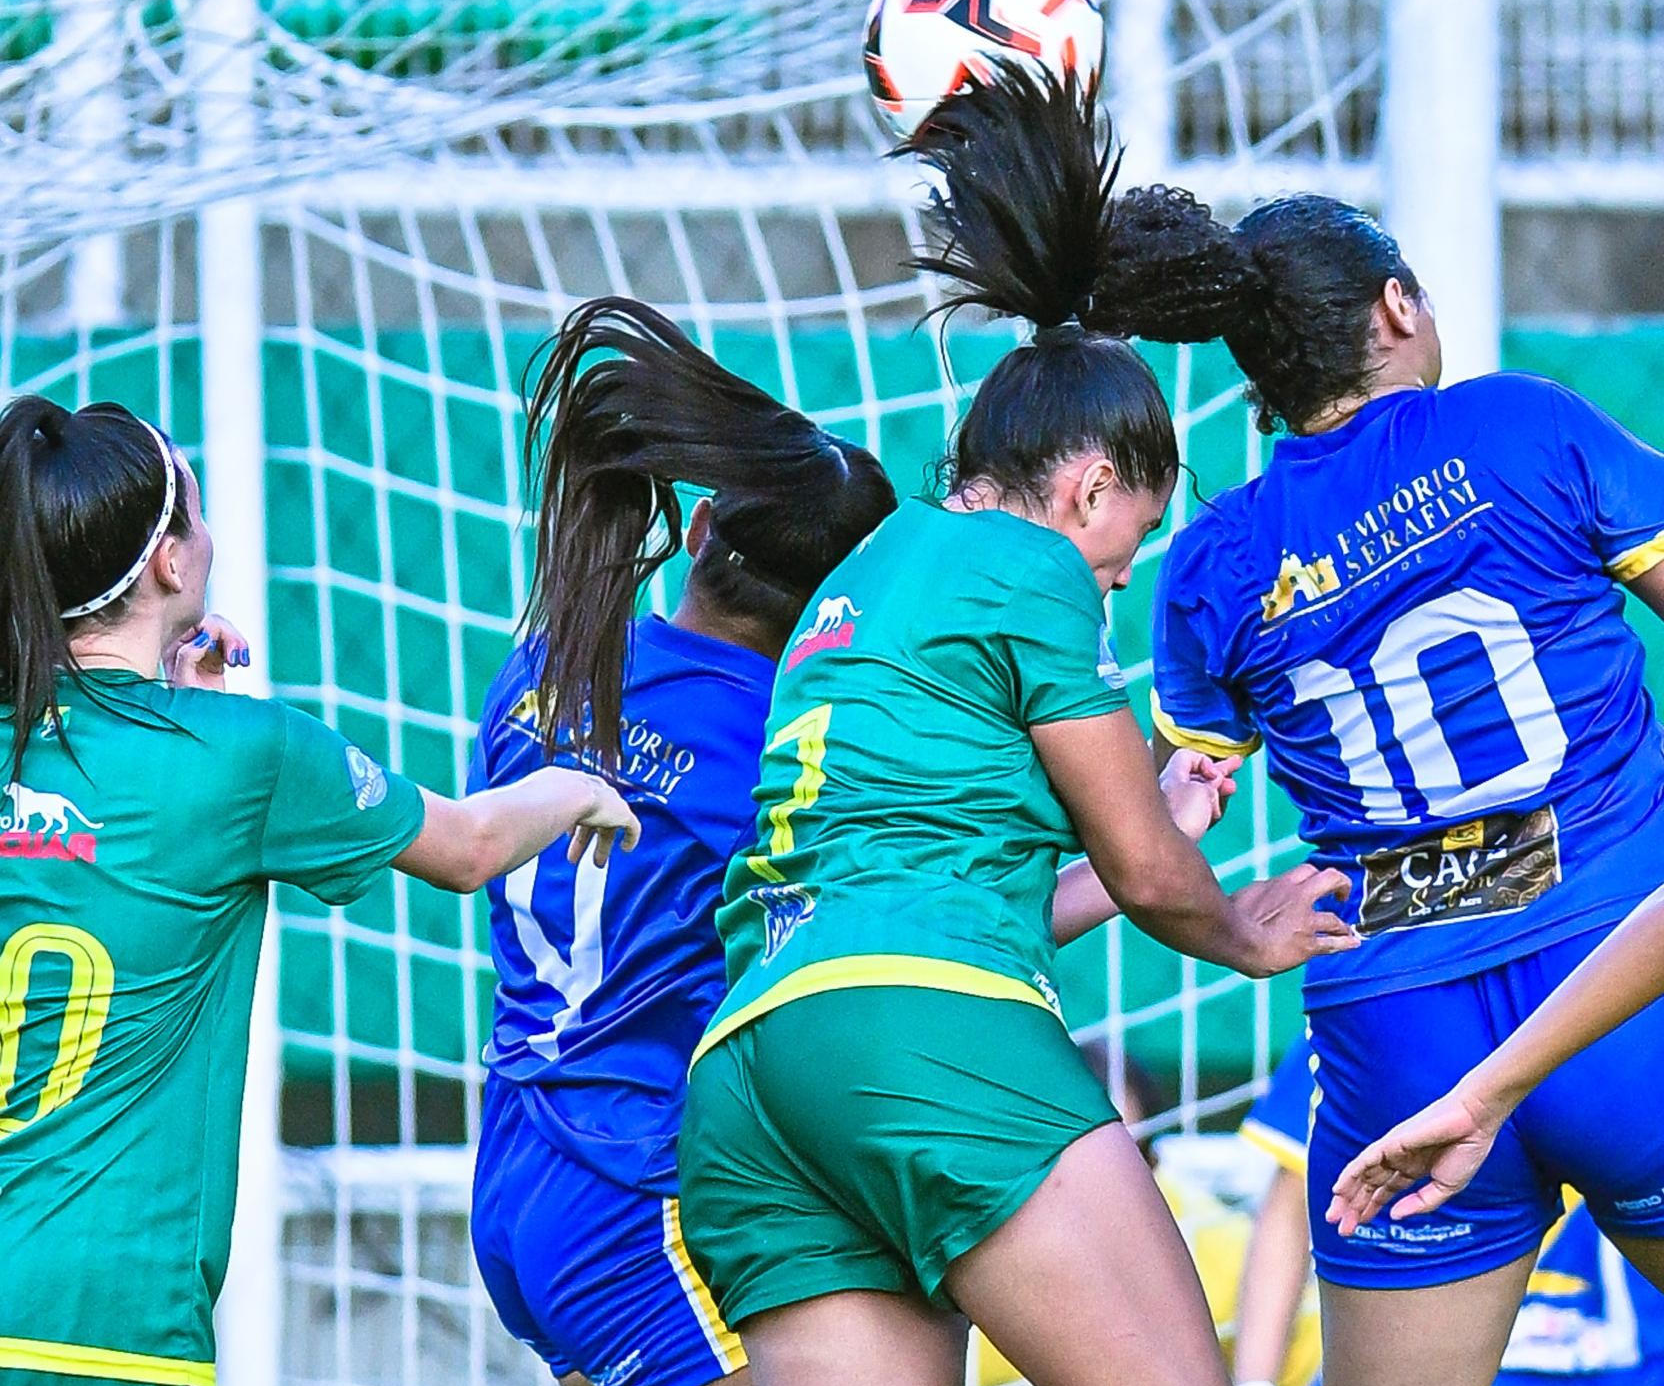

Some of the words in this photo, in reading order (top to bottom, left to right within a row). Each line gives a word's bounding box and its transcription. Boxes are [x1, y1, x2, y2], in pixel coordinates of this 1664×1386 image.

[1337, 457, 1466, 555] EMPÓRIO
[1346, 479, 1478, 580] SERAFIM
[1285, 587, 1569, 825] 10
